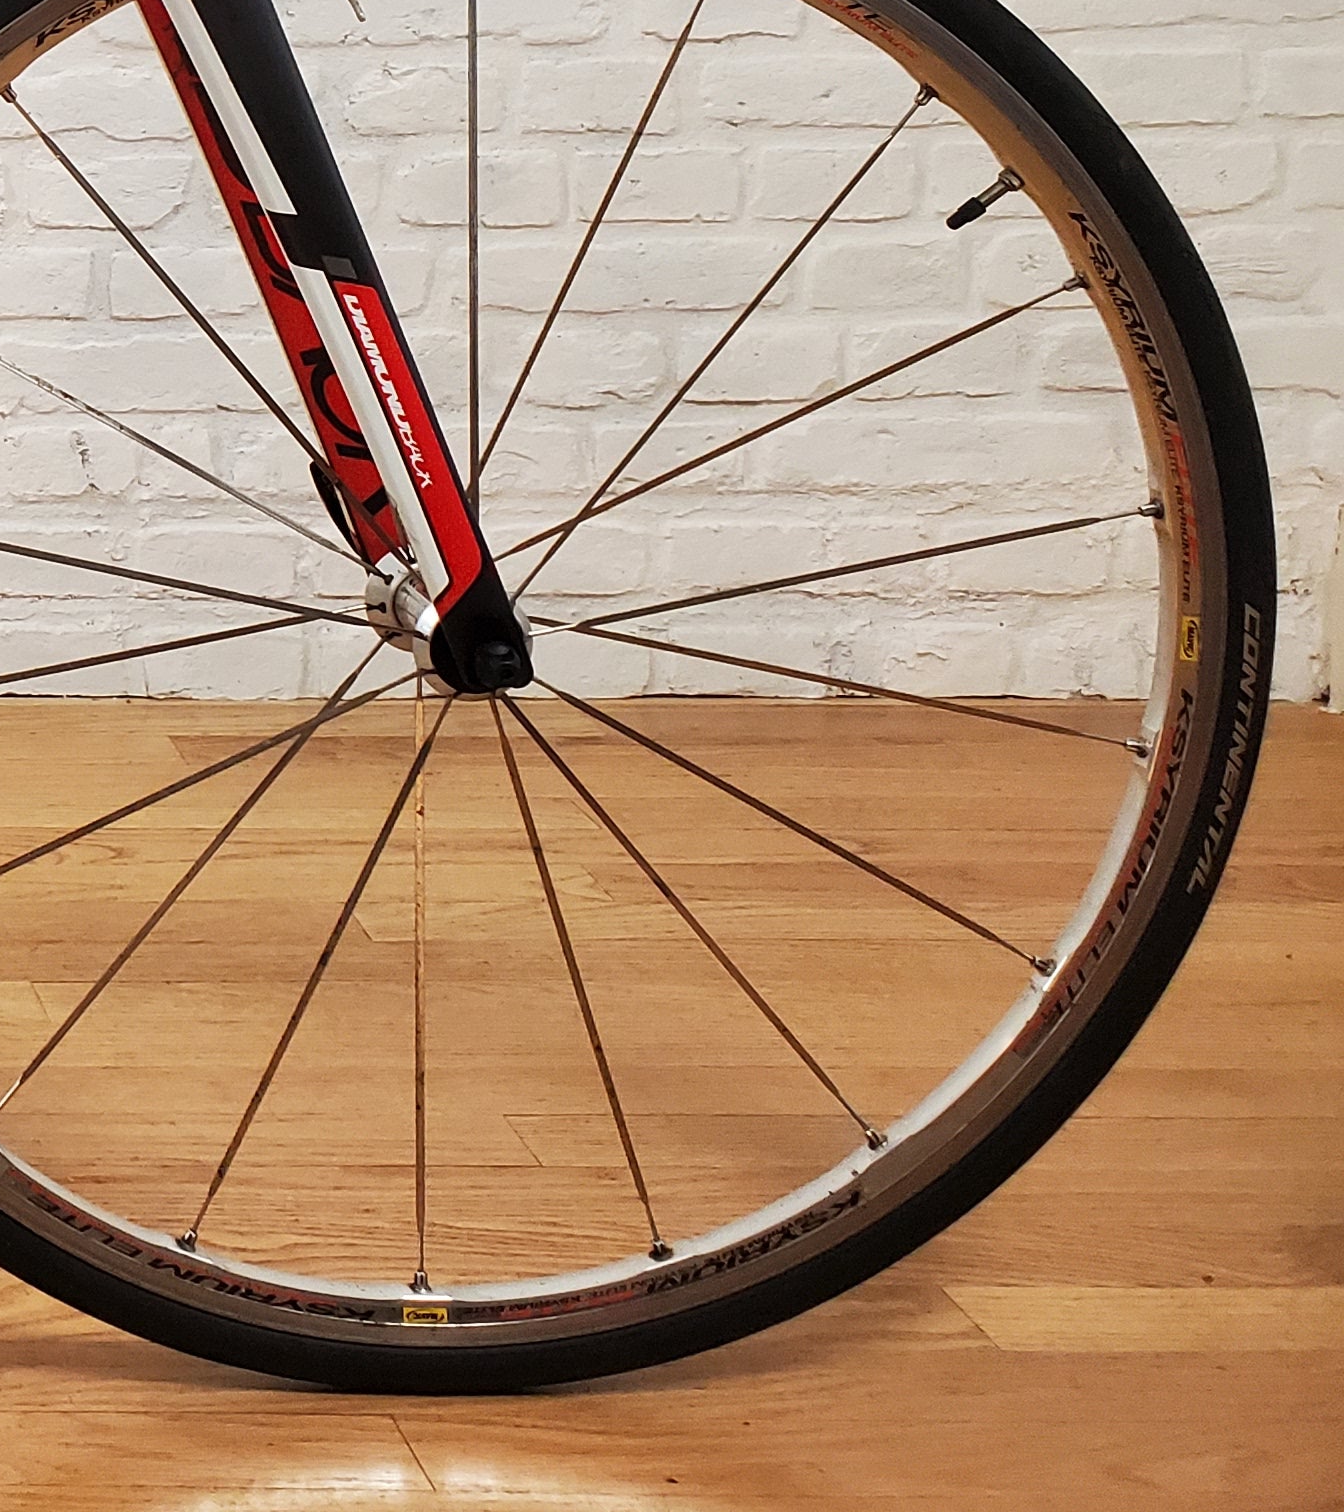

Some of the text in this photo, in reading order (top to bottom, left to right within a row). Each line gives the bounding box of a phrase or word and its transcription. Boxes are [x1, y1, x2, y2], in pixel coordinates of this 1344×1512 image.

[342, 293, 434, 488] DIAMONDBACK
[1066, 206, 1179, 424] KSYRIUM
[1113, 687, 1195, 916] KSYRIUM
[1181, 602, 1259, 901] CONTINENTAL
[27, 1189, 143, 1262] ELITE
[146, 1253, 375, 1323] KSYRIUM
